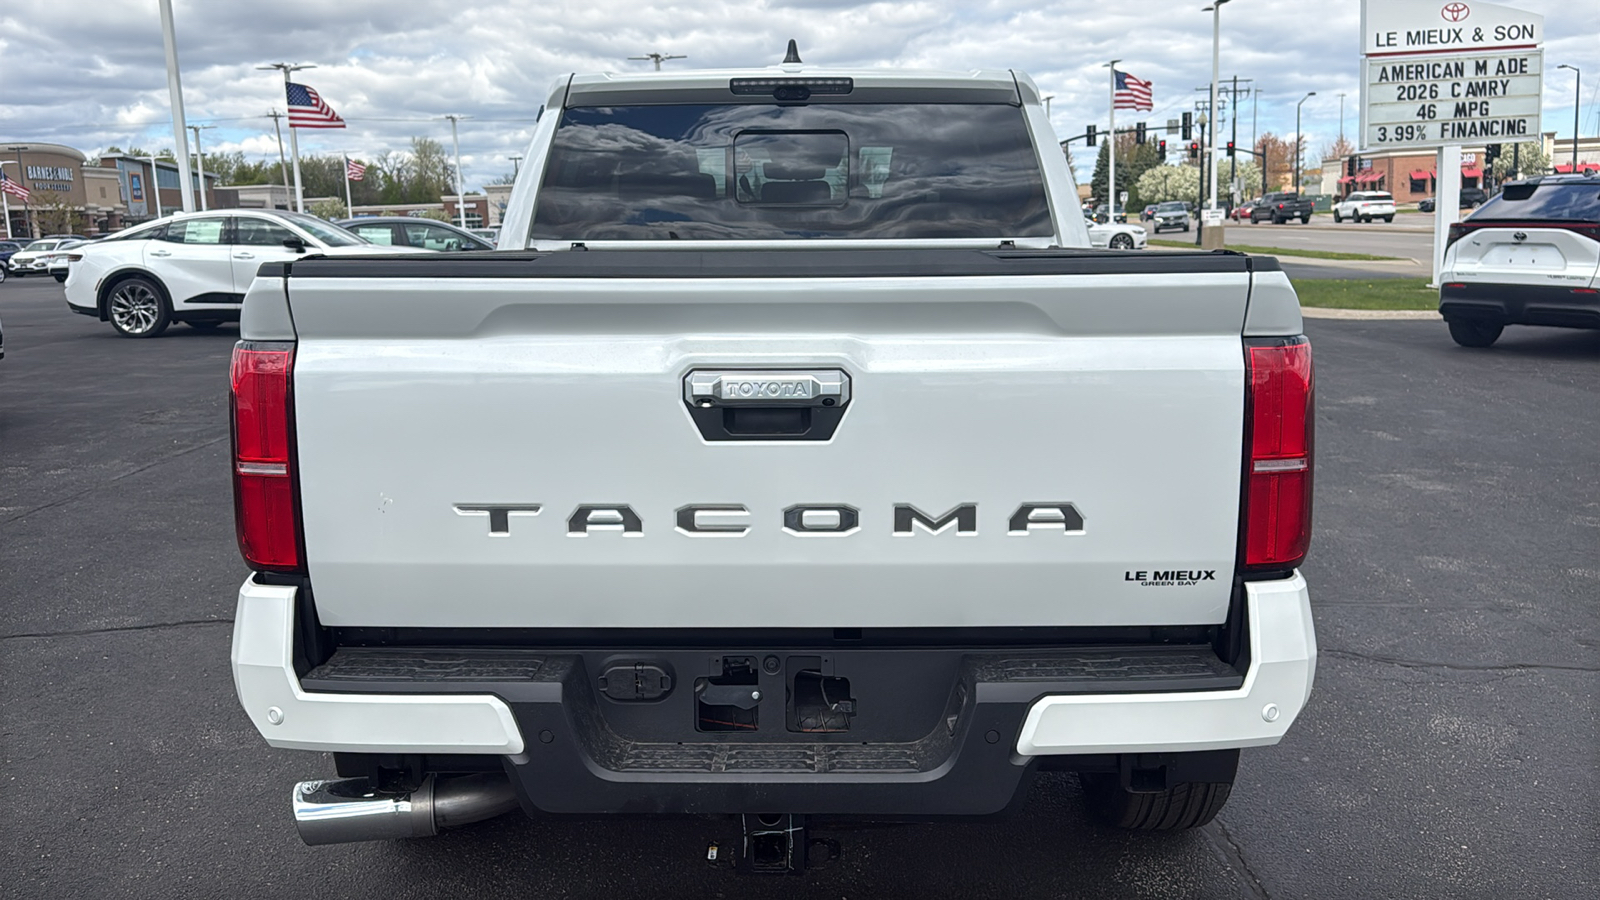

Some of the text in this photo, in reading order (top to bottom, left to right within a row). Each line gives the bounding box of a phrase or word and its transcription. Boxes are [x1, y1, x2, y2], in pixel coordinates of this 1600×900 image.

[1376, 24, 1534, 48] LE MIEUX & SON
[1378, 61, 1465, 83] AMERICAN
[1396, 79, 1510, 101] 2026 CAMRY
[1416, 101, 1490, 120] 46 MPG
[1377, 119, 1527, 142] 3.99% FINANCING
[726, 382, 808, 397] TOYOTA
[452, 501, 1087, 538] TACOMA
[1125, 570, 1216, 581] LE MIEUX
